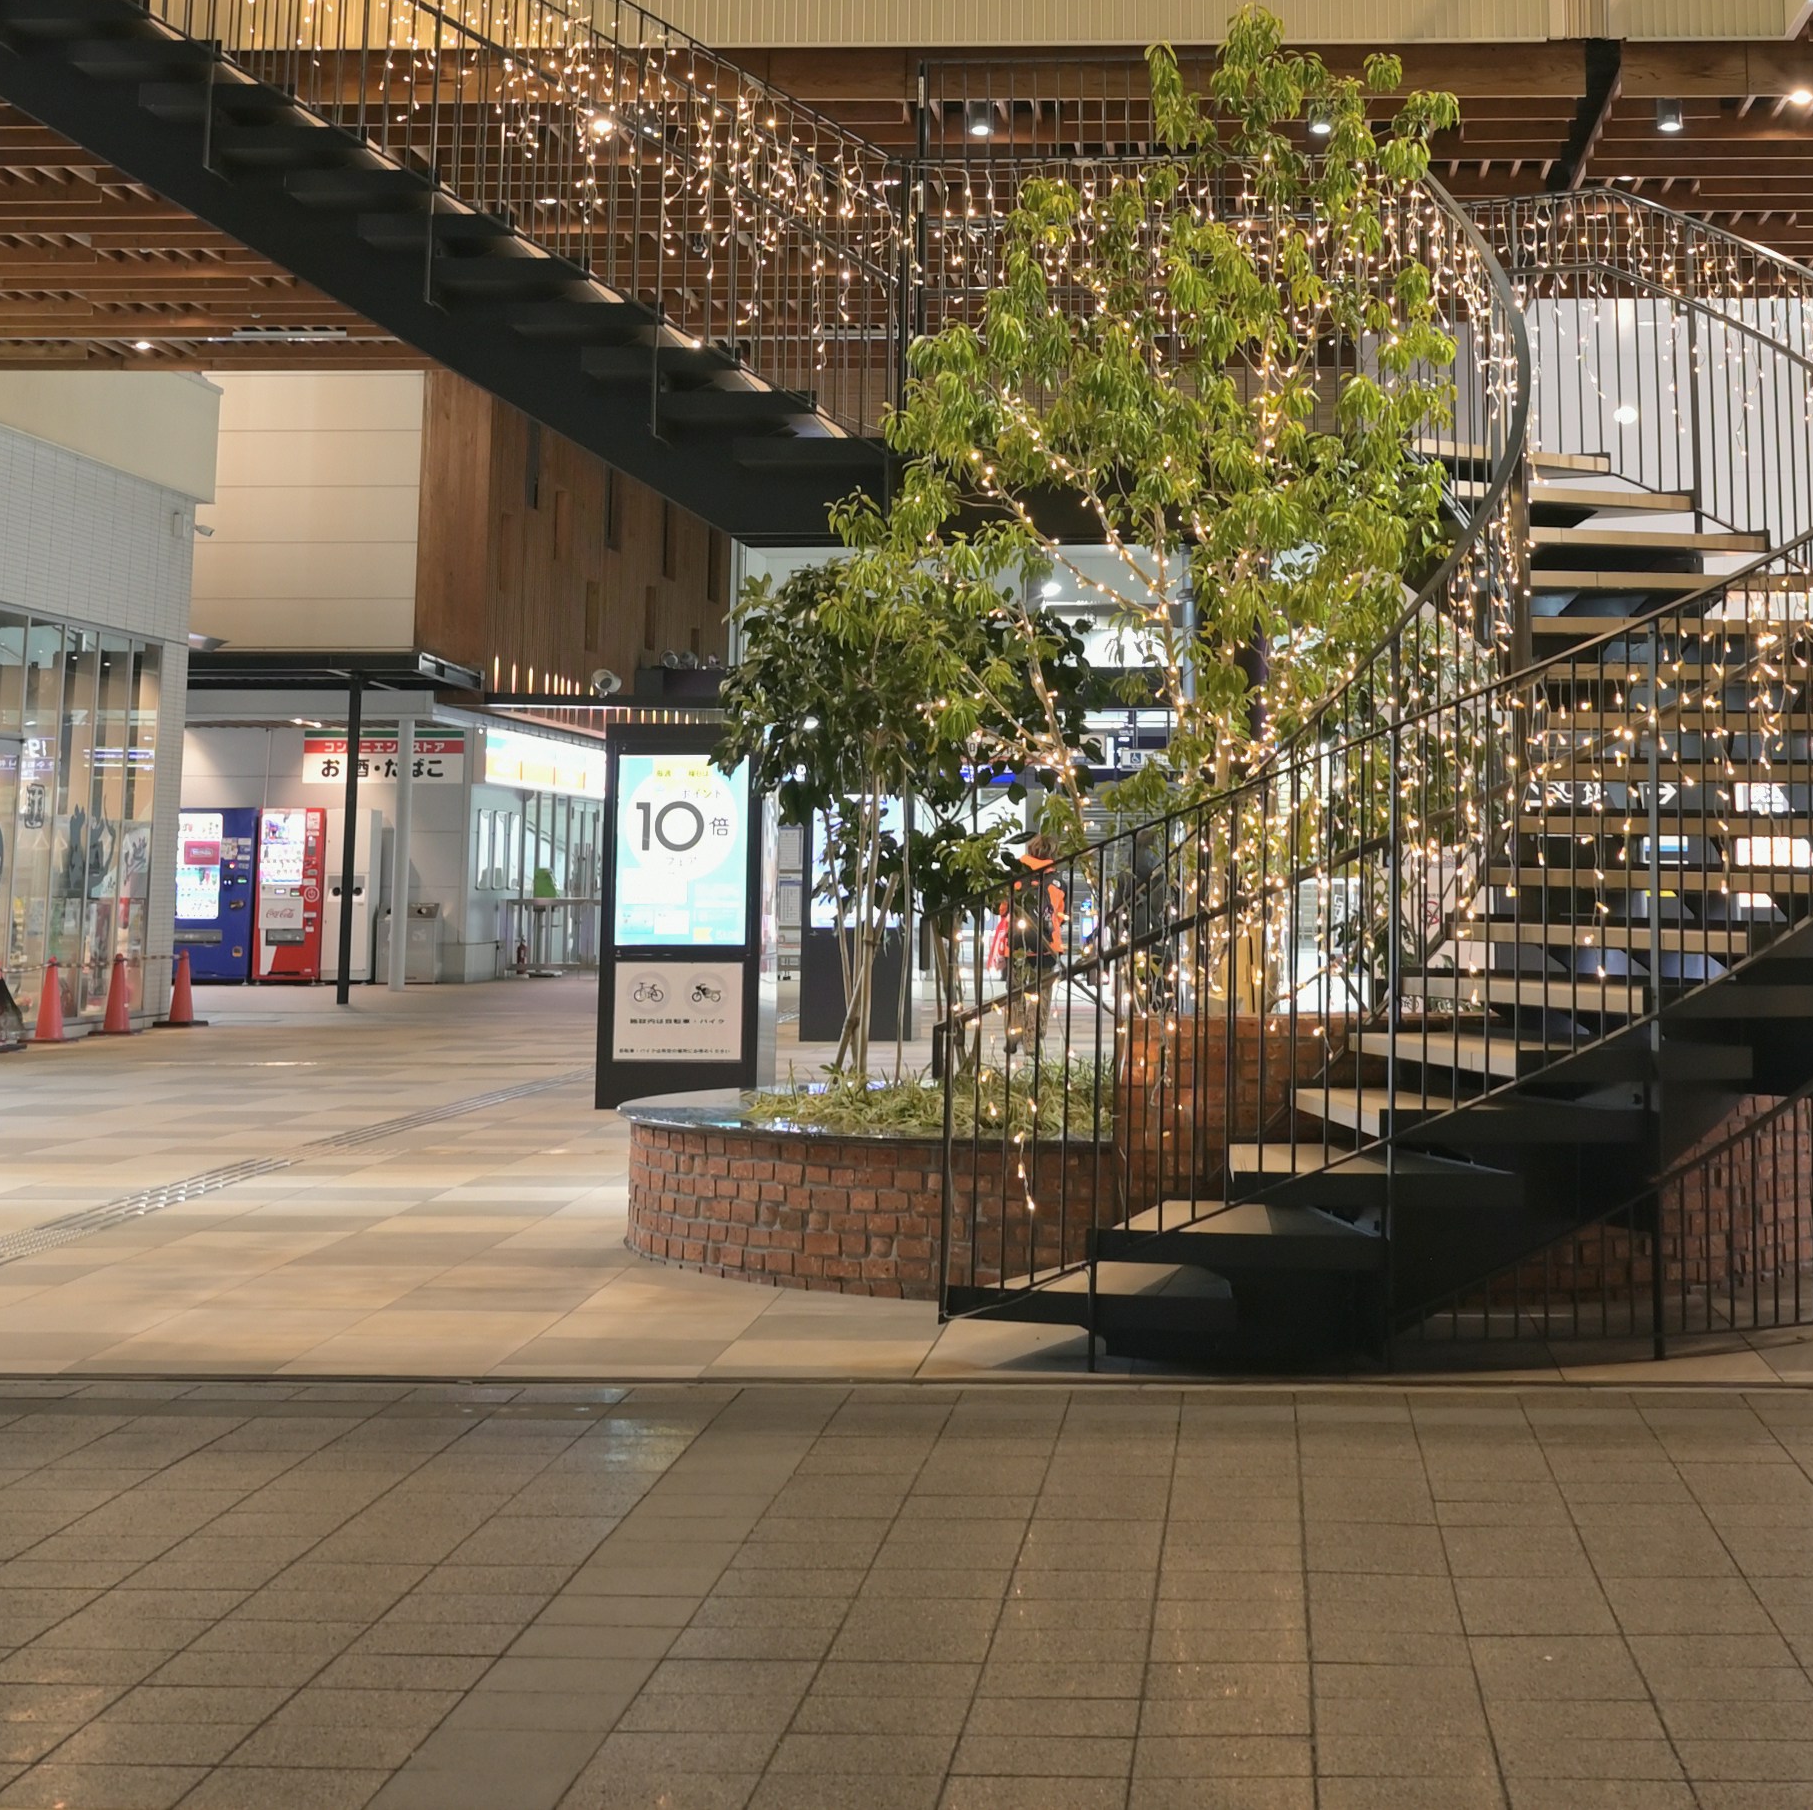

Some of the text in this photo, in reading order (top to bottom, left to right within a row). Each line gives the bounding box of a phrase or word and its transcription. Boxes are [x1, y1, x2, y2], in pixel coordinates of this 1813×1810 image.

[324, 741, 446, 753] コンニエンストア
